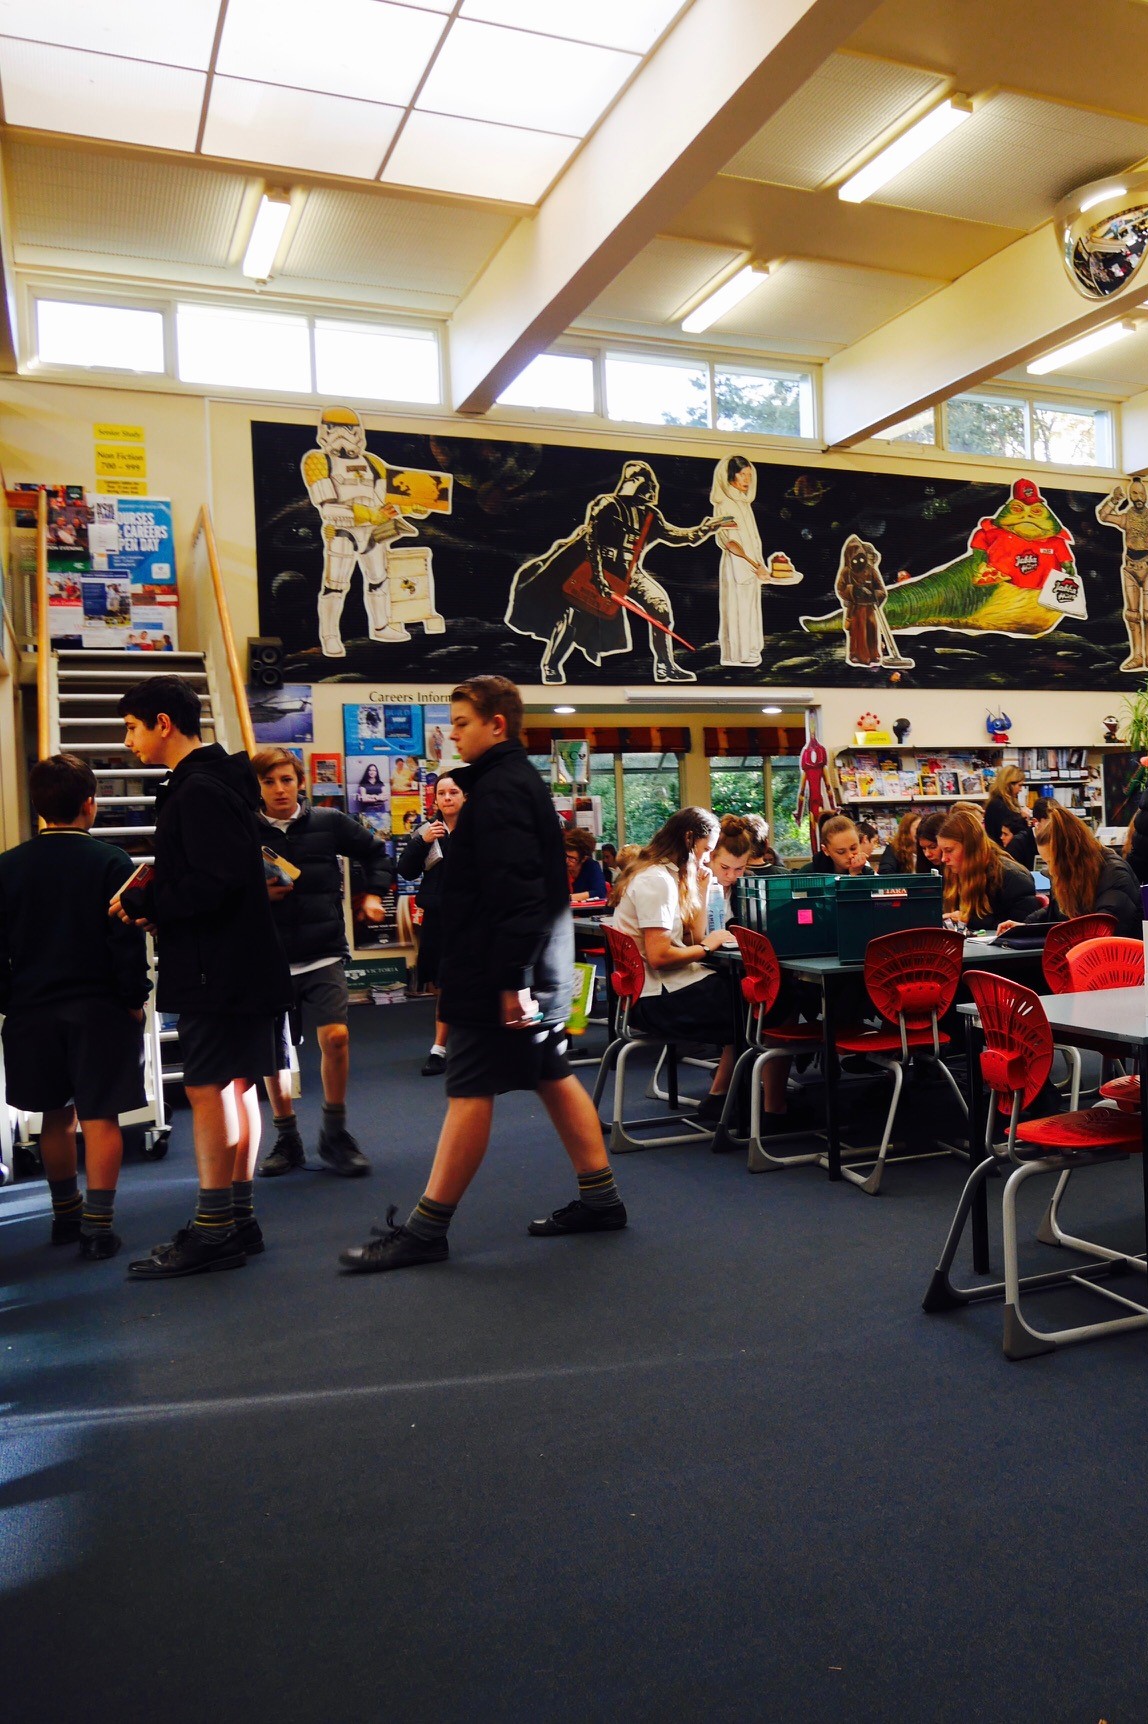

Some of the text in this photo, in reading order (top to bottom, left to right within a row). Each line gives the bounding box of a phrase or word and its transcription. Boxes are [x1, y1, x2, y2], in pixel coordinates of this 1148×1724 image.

[123, 525, 168, 539] CAREERS
[140, 538, 160, 552] DAY
[369, 690, 452, 702] Careers Inform
